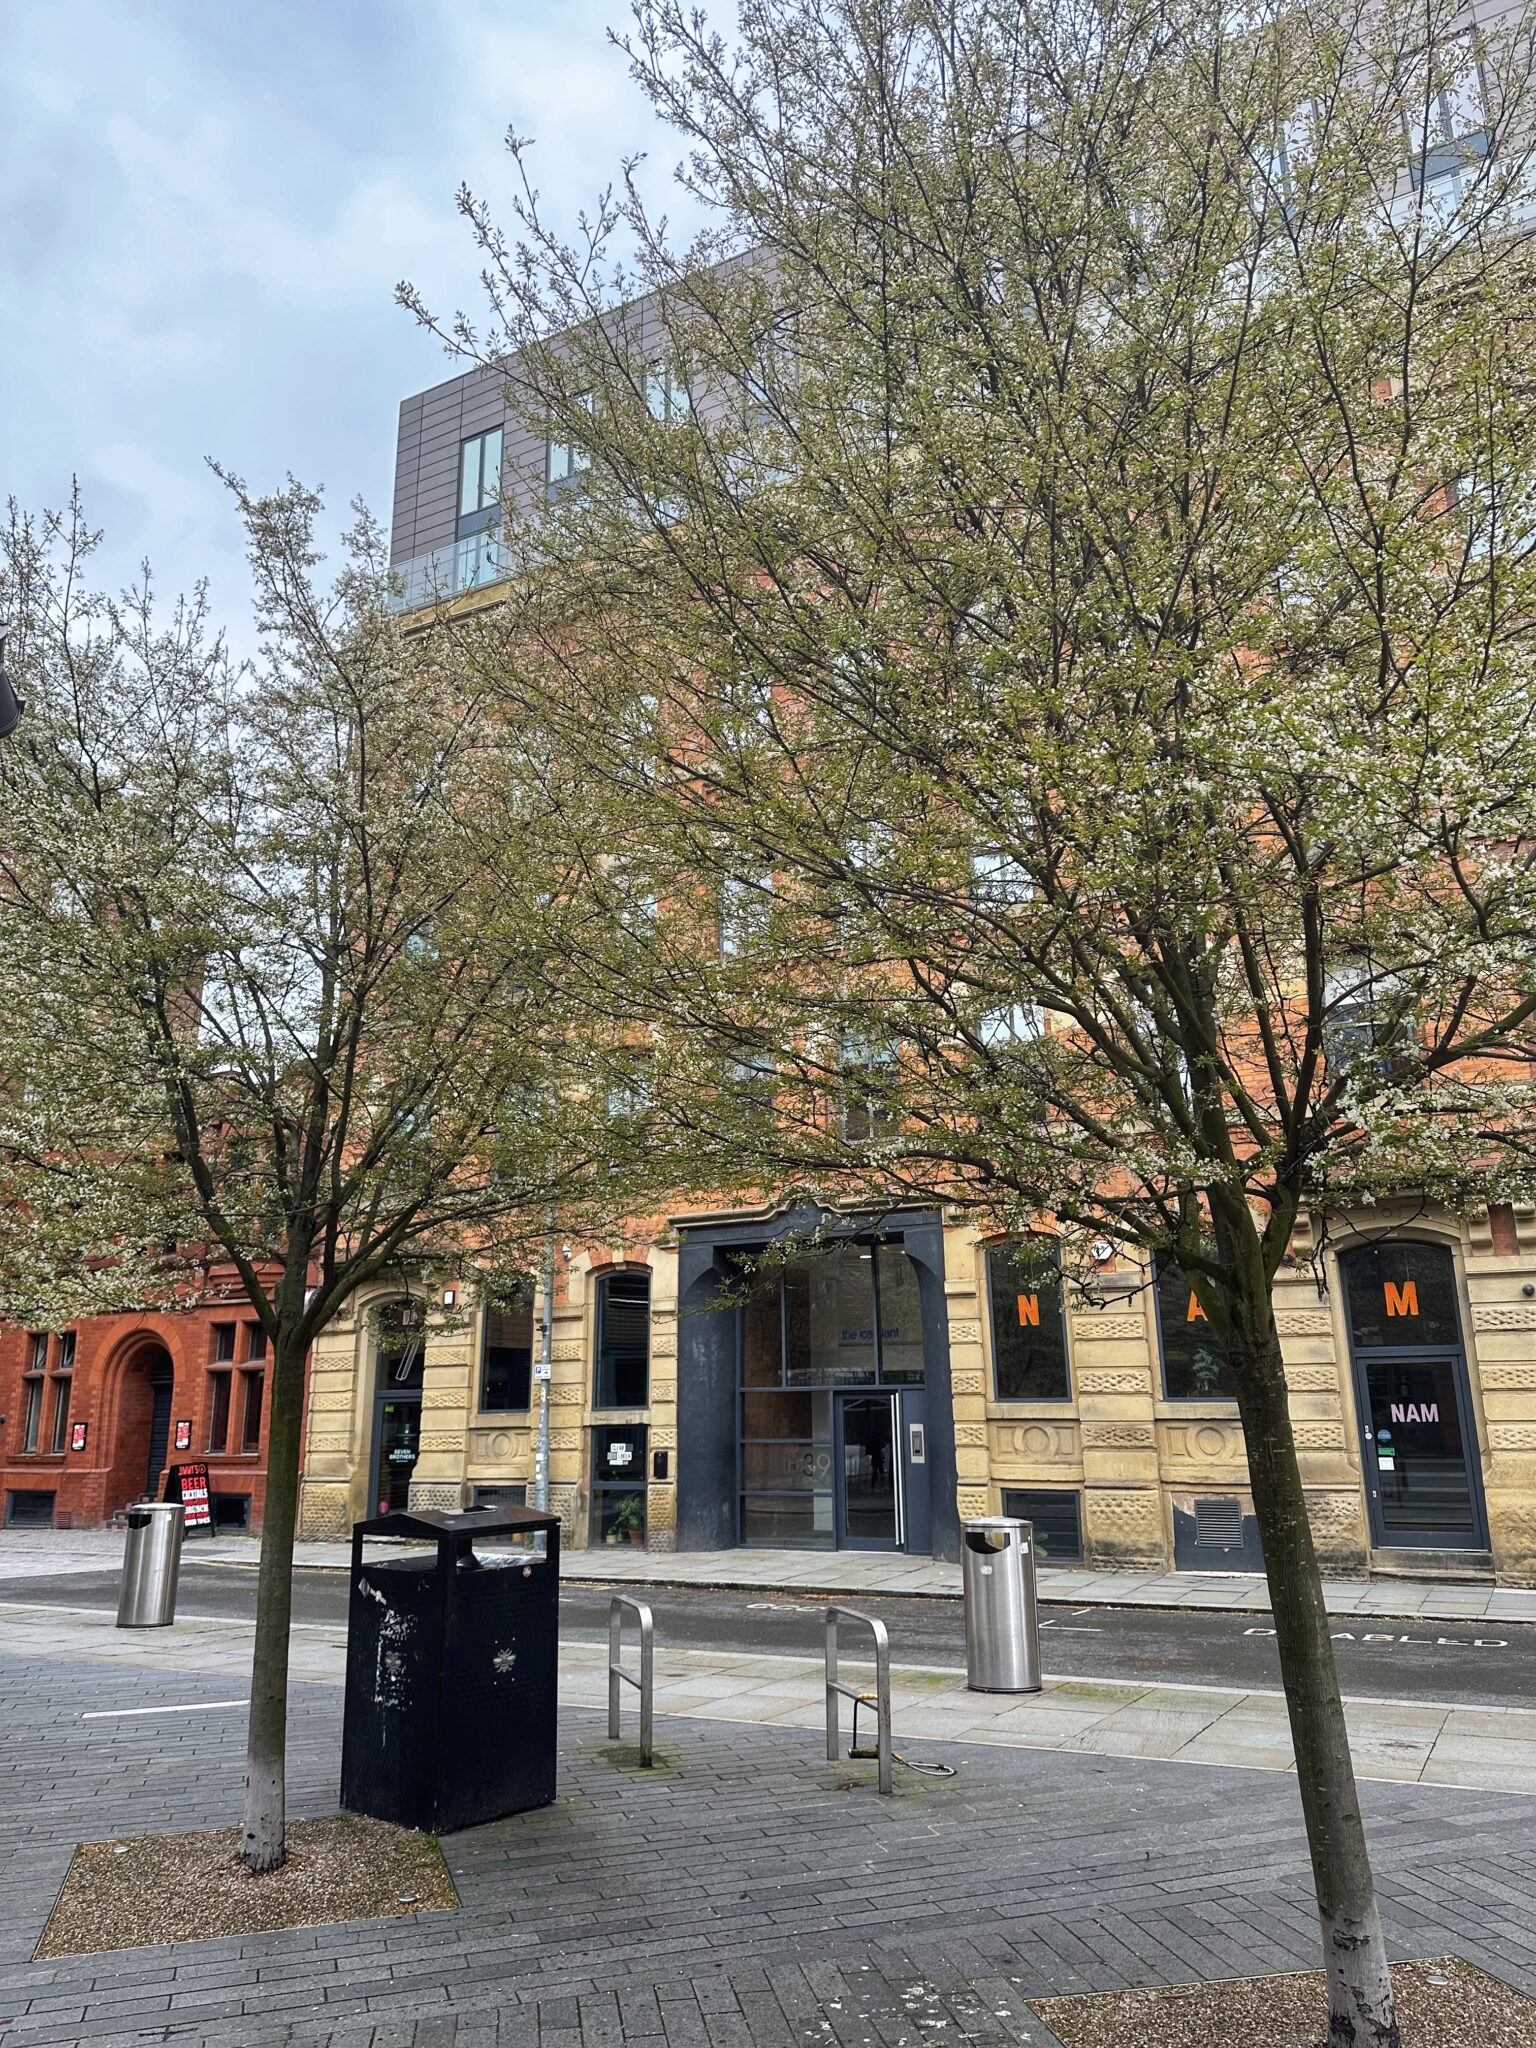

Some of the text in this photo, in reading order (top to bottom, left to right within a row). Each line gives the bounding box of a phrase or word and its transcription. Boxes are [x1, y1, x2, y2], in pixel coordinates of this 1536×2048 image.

[1017, 1281, 1419, 1326] N A M
[1390, 1403, 1439, 1423] NAM
[181, 1477, 206, 1490] BEER
[1243, 1628, 1509, 1647] DABLED
